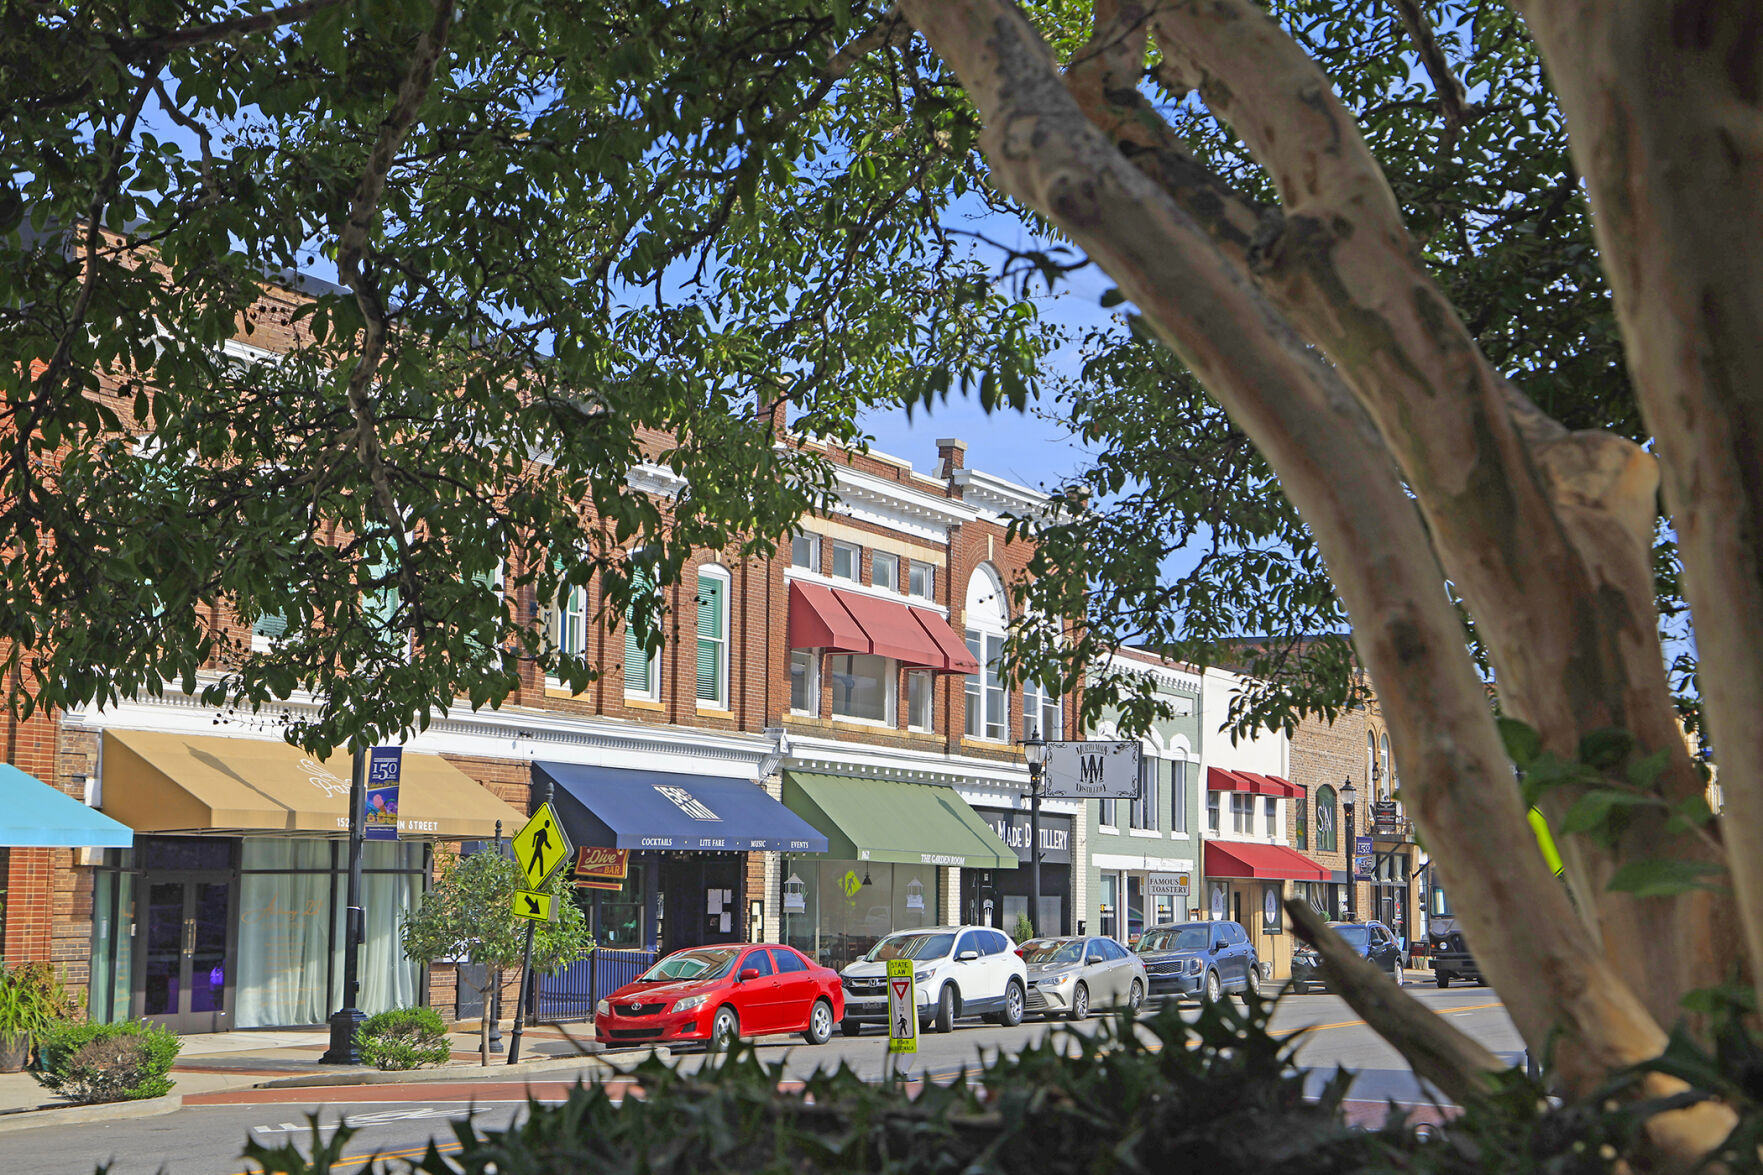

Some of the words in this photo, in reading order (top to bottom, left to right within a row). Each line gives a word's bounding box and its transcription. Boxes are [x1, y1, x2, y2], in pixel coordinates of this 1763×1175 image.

[372, 762, 397, 780] 150
[409, 821, 438, 831] STREET
[1024, 822, 1068, 850] DTILLERY
[641, 838, 672, 846] COCKTAILS
[700, 838, 711, 847] LITE
[712, 839, 725, 847] FARE
[750, 840, 766, 848] MUSIC
[791, 841, 808, 849] EVENTS
[585, 849, 617, 864] Dive
[920, 854, 932, 863] THE
[604, 866, 620, 874] BAR
